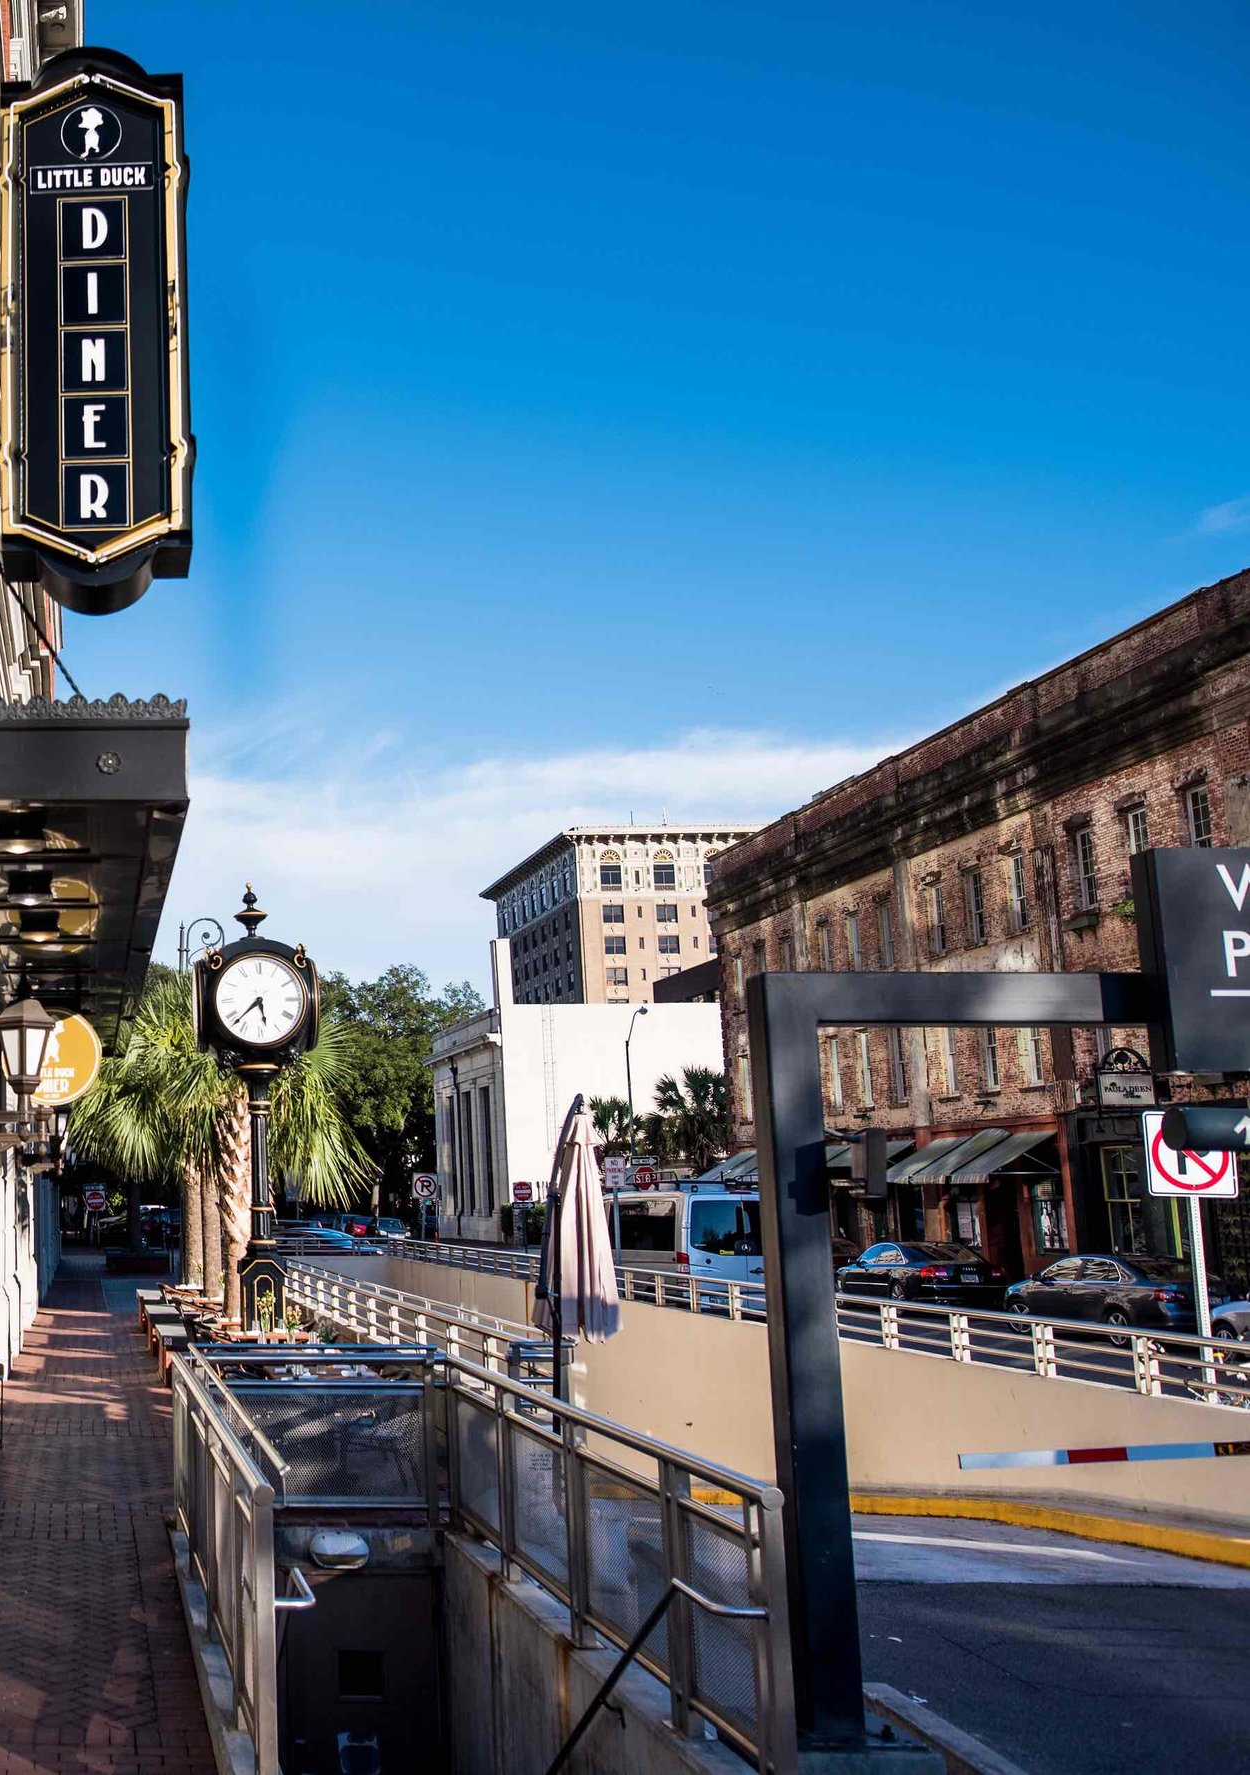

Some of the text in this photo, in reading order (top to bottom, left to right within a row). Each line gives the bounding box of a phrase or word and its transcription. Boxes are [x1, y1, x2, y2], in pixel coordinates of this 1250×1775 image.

[37, 166, 146, 189] LITTLE DUCK
[80, 207, 110, 519] DINER
